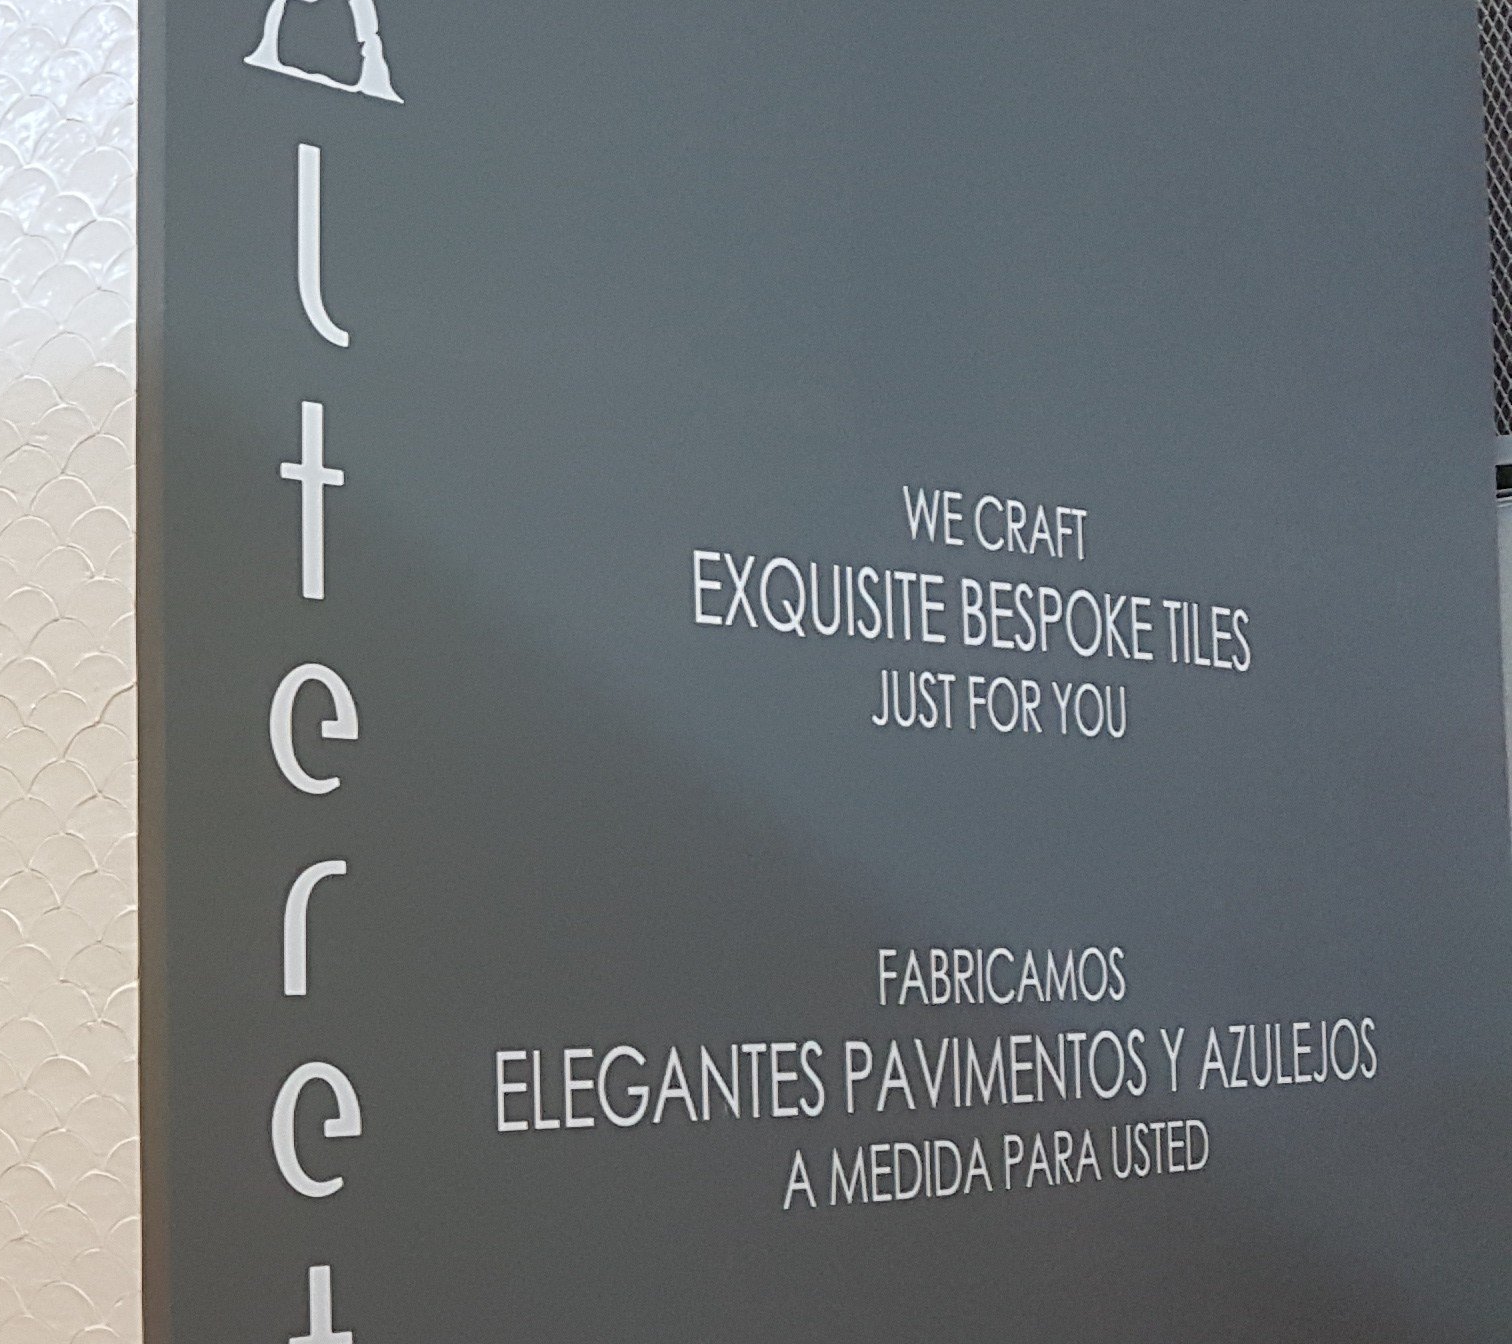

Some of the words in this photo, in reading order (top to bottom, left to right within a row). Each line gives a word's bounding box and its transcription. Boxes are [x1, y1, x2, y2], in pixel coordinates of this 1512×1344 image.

[902, 485, 965, 546] WE
[974, 495, 1088, 561] CRAFT
[692, 549, 947, 644] EXQUISITE
[960, 577, 1154, 661] BESPOKE
[1162, 599, 1251, 672] TILES
[871, 669, 957, 729] JUST
[967, 675, 1043, 733] FOR
[1051, 681, 1127, 738] YOU
[878, 946, 1126, 1006] FABRICAMOS
[495, 1040, 825, 1132] ELEGANTES
[844, 1028, 1148, 1118] PAVIMENTOS
[1159, 1027, 1185, 1093] Y
[1198, 1017, 1378, 1091] AZULEJOS
[783, 1149, 817, 1210] A
[829, 1140, 993, 1206] MEDIDA
[1003, 1128, 1102, 1191] PARA
[1111, 1119, 1209, 1179] USTED
